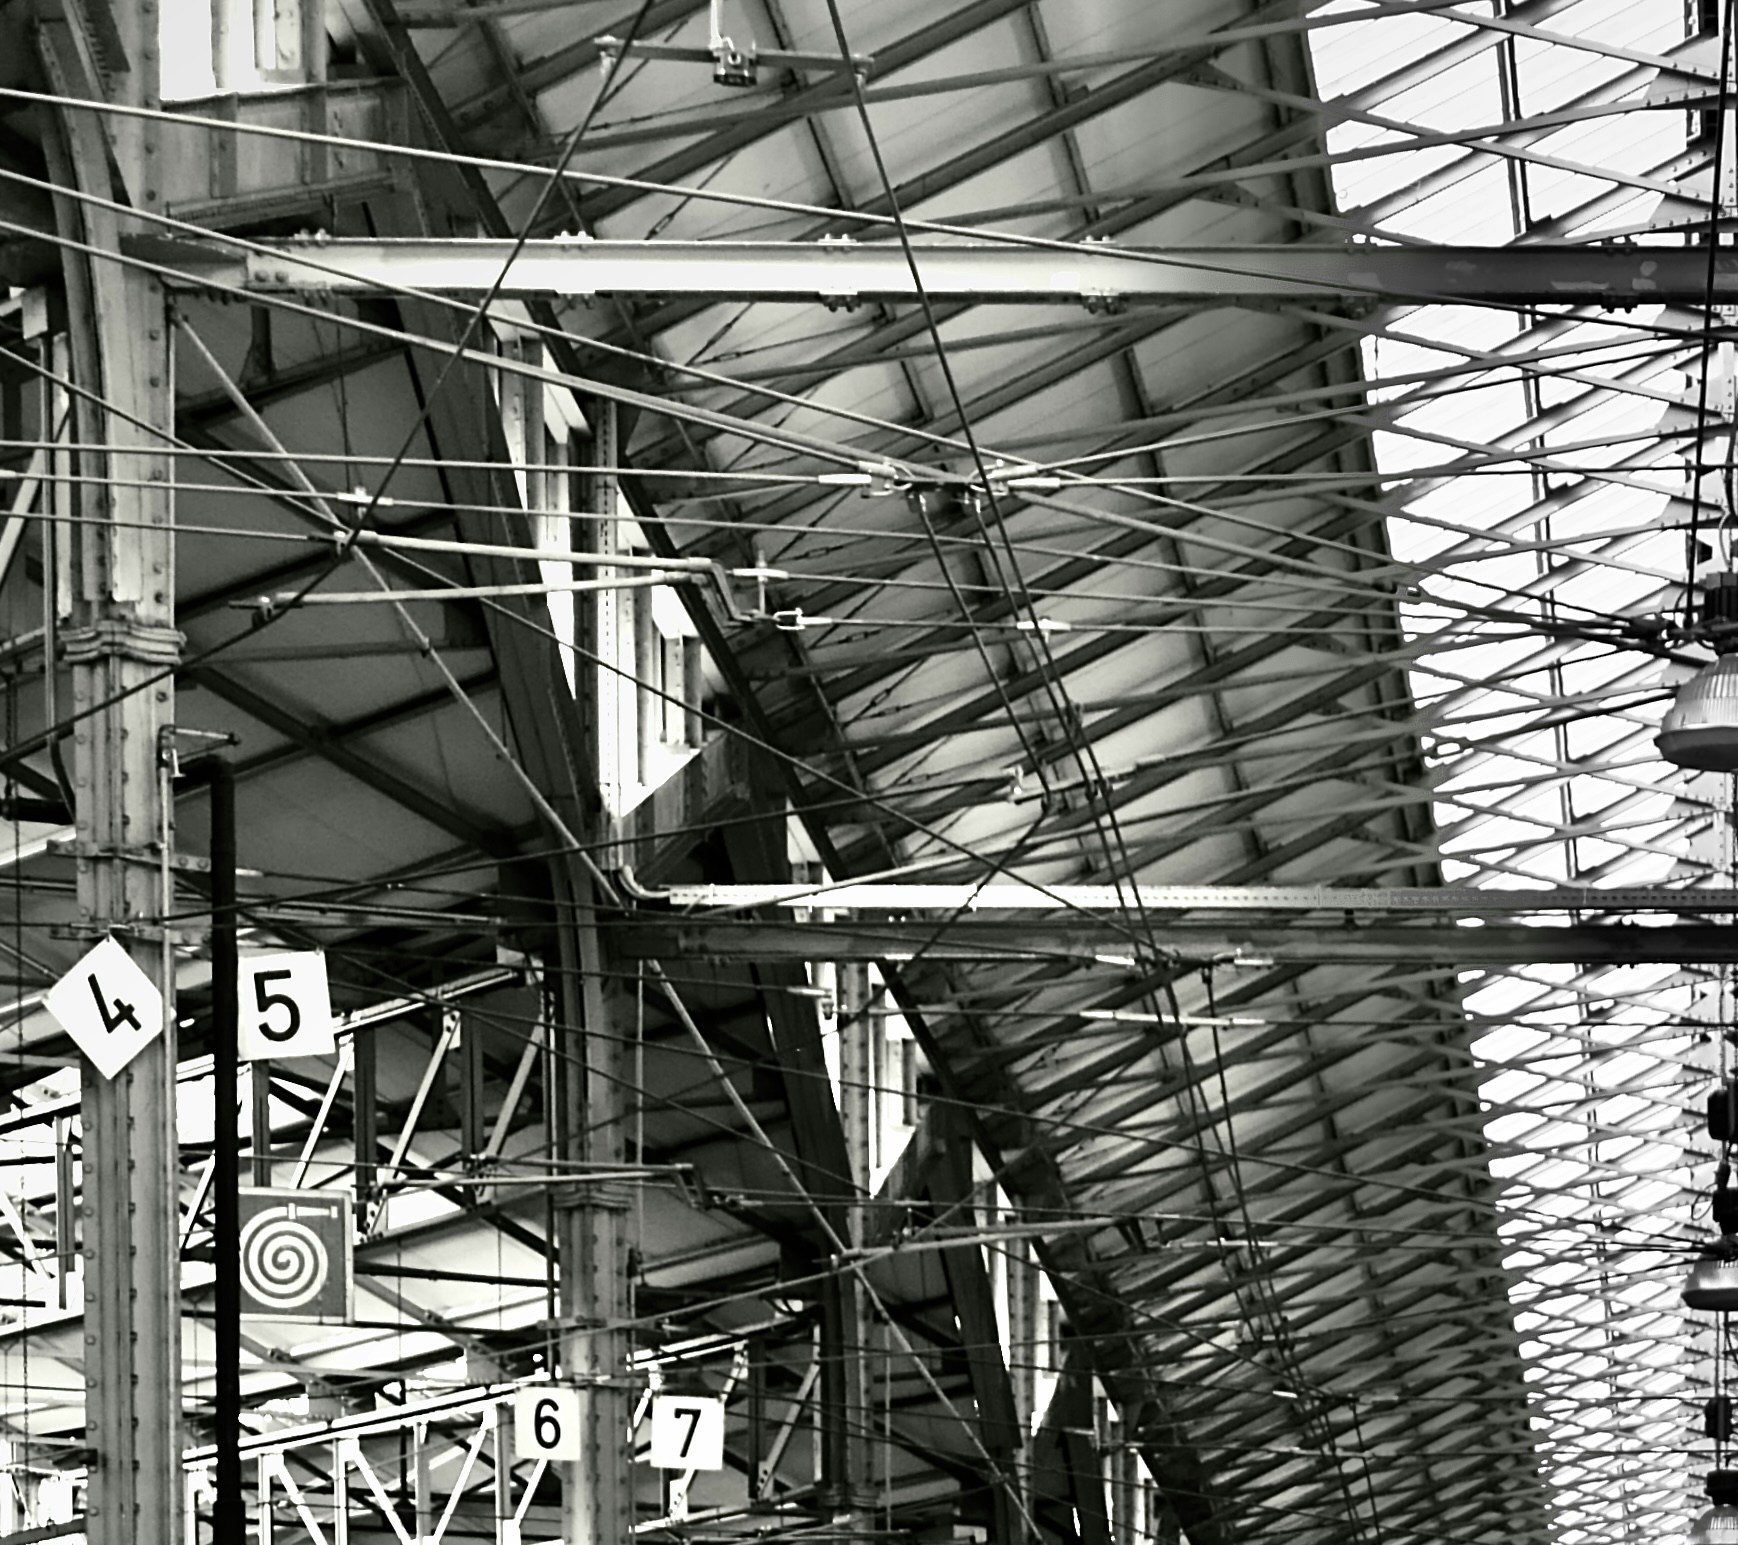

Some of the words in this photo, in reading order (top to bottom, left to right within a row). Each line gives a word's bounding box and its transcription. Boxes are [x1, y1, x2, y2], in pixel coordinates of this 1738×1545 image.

[87, 973, 142, 1033] 4
[253, 969, 301, 1042] 5
[533, 1398, 561, 1449] 6
[673, 1407, 702, 1457] 7
